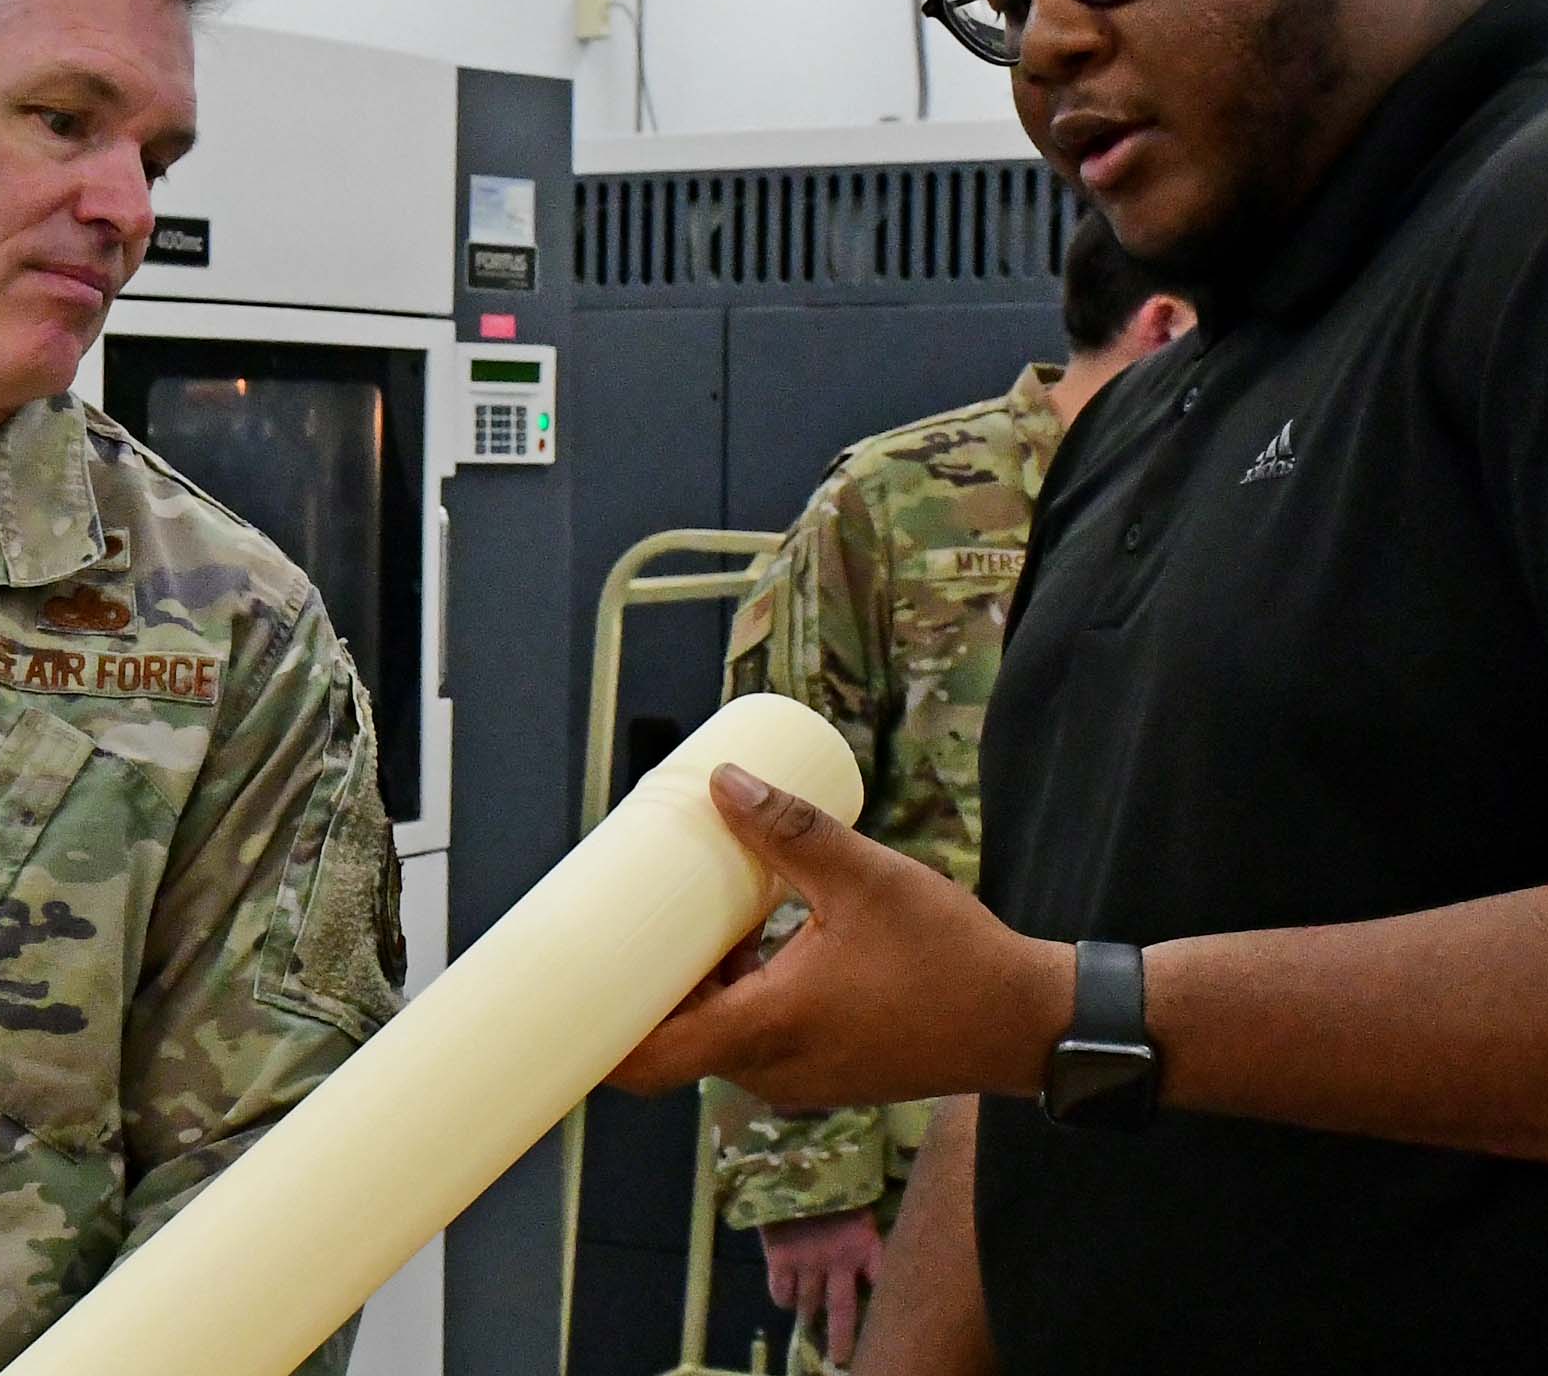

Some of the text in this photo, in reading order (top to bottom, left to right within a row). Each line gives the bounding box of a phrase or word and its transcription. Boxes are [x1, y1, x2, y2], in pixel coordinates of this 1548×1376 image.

[956, 551, 1025, 574] MYERS
[23, 648, 87, 689] AIR
[96, 655, 217, 698] FORCE
